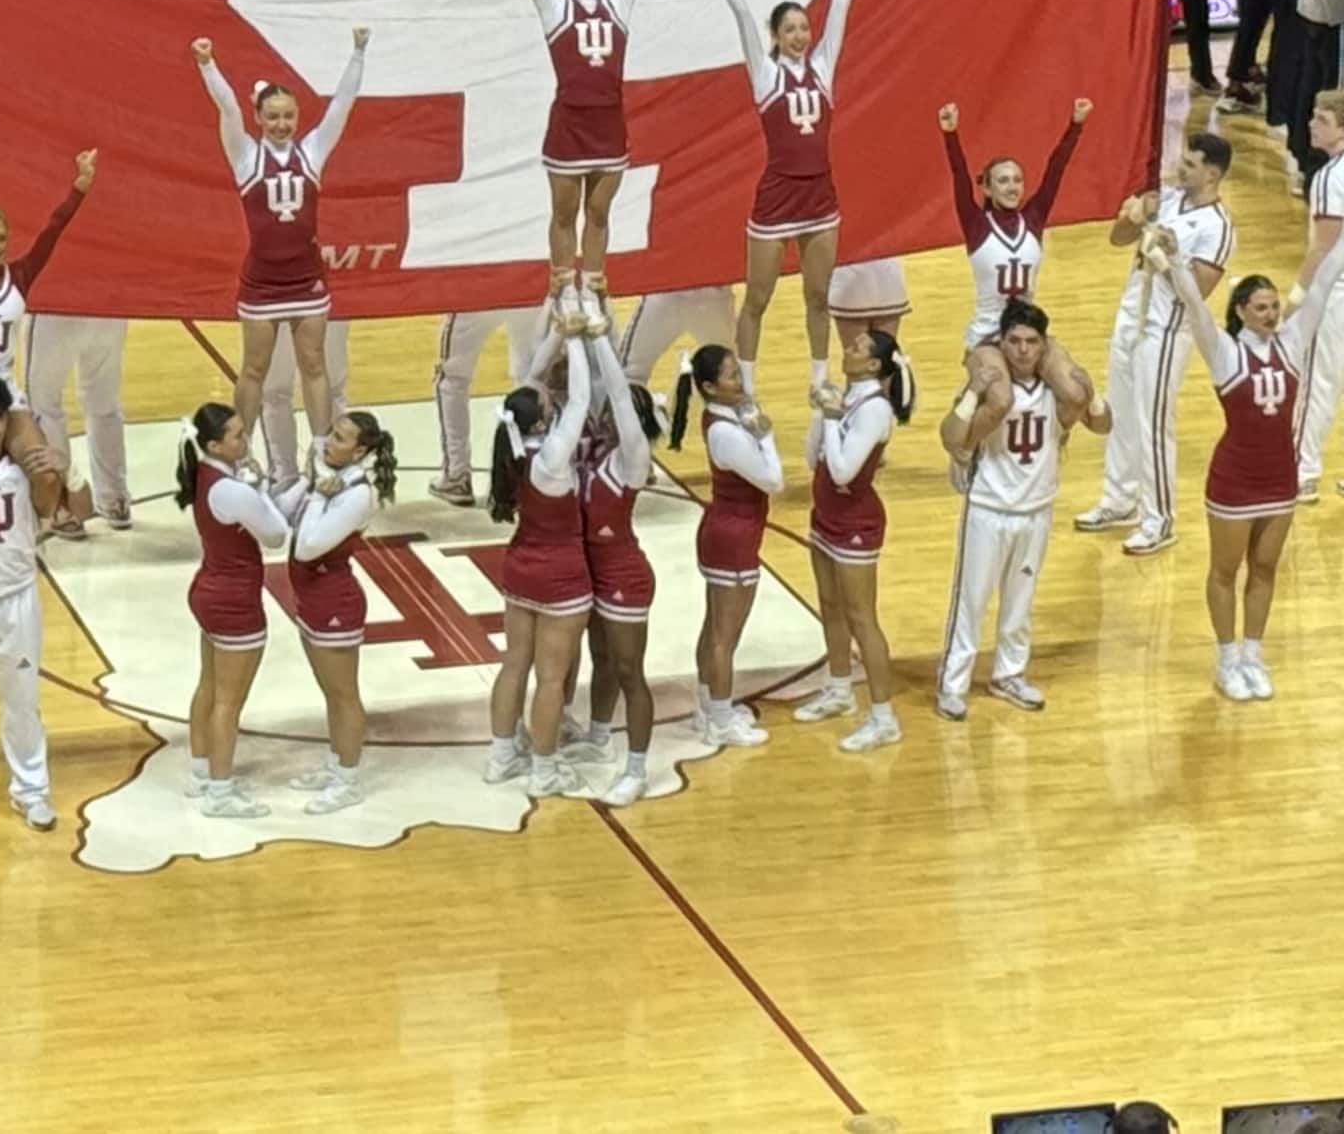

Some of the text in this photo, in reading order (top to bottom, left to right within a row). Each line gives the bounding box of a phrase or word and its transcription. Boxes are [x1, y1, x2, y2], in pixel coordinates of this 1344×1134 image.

[575, 17, 613, 66] IU
[785, 86, 822, 135] IU
[264, 170, 304, 223] IU
[996, 257, 1033, 300] IU
[1252, 367, 1287, 415] IU
[1006, 410, 1047, 465] IU
